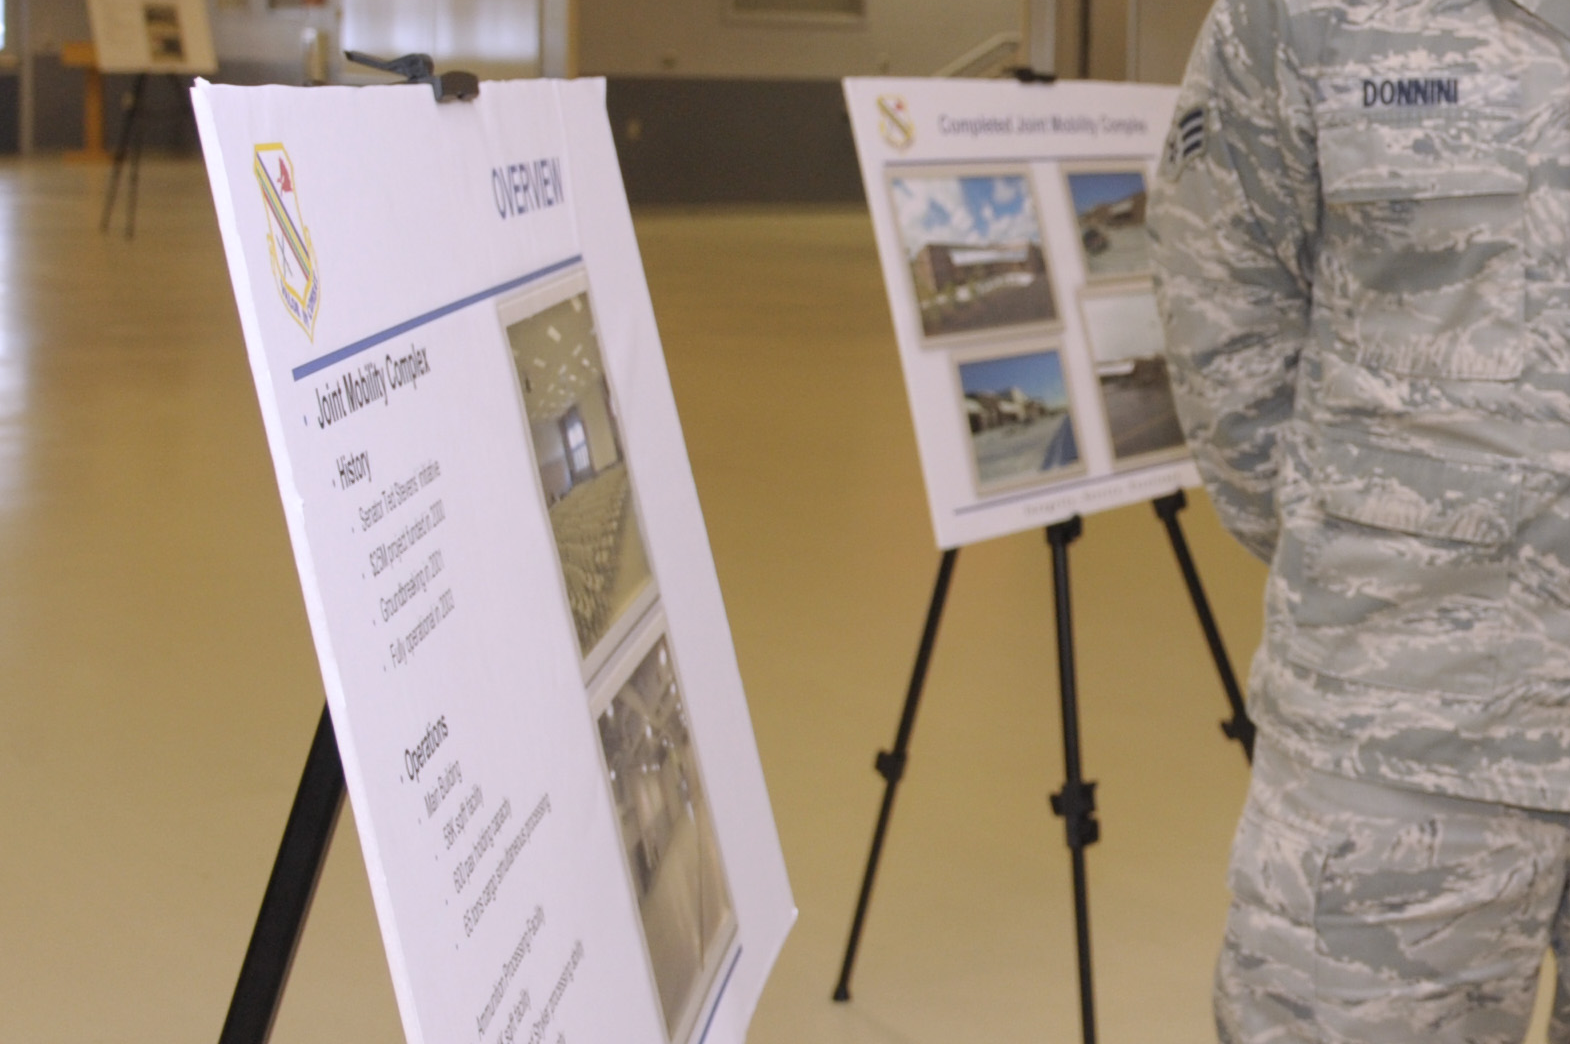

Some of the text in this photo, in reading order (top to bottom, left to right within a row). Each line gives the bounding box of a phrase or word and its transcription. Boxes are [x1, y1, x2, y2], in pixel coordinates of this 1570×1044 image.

[1363, 78, 1459, 107] DONNINI
[938, 114, 1012, 139] Completed
[1017, 116, 1046, 136] Joint
[1052, 116, 1099, 140] Mobility
[491, 158, 564, 219] OVERVIEW
[315, 342, 431, 429] Joint Mobility Complex
[336, 450, 371, 490] History
[358, 499, 384, 532] Senator
[381, 485, 397, 514] Ted
[386, 531, 408, 569] project
[404, 514, 427, 546] funded
[425, 512, 431, 533] in
[380, 566, 427, 622] Groundbreaking
[424, 562, 430, 583] in
[389, 637, 407, 668] Fully
[405, 606, 436, 656] operational
[434, 604, 440, 625] in
[404, 714, 449, 784] Operations
[423, 759, 462, 819] Main Building
[472, 824, 494, 864] holding
[476, 974, 505, 1041] Ammunition
